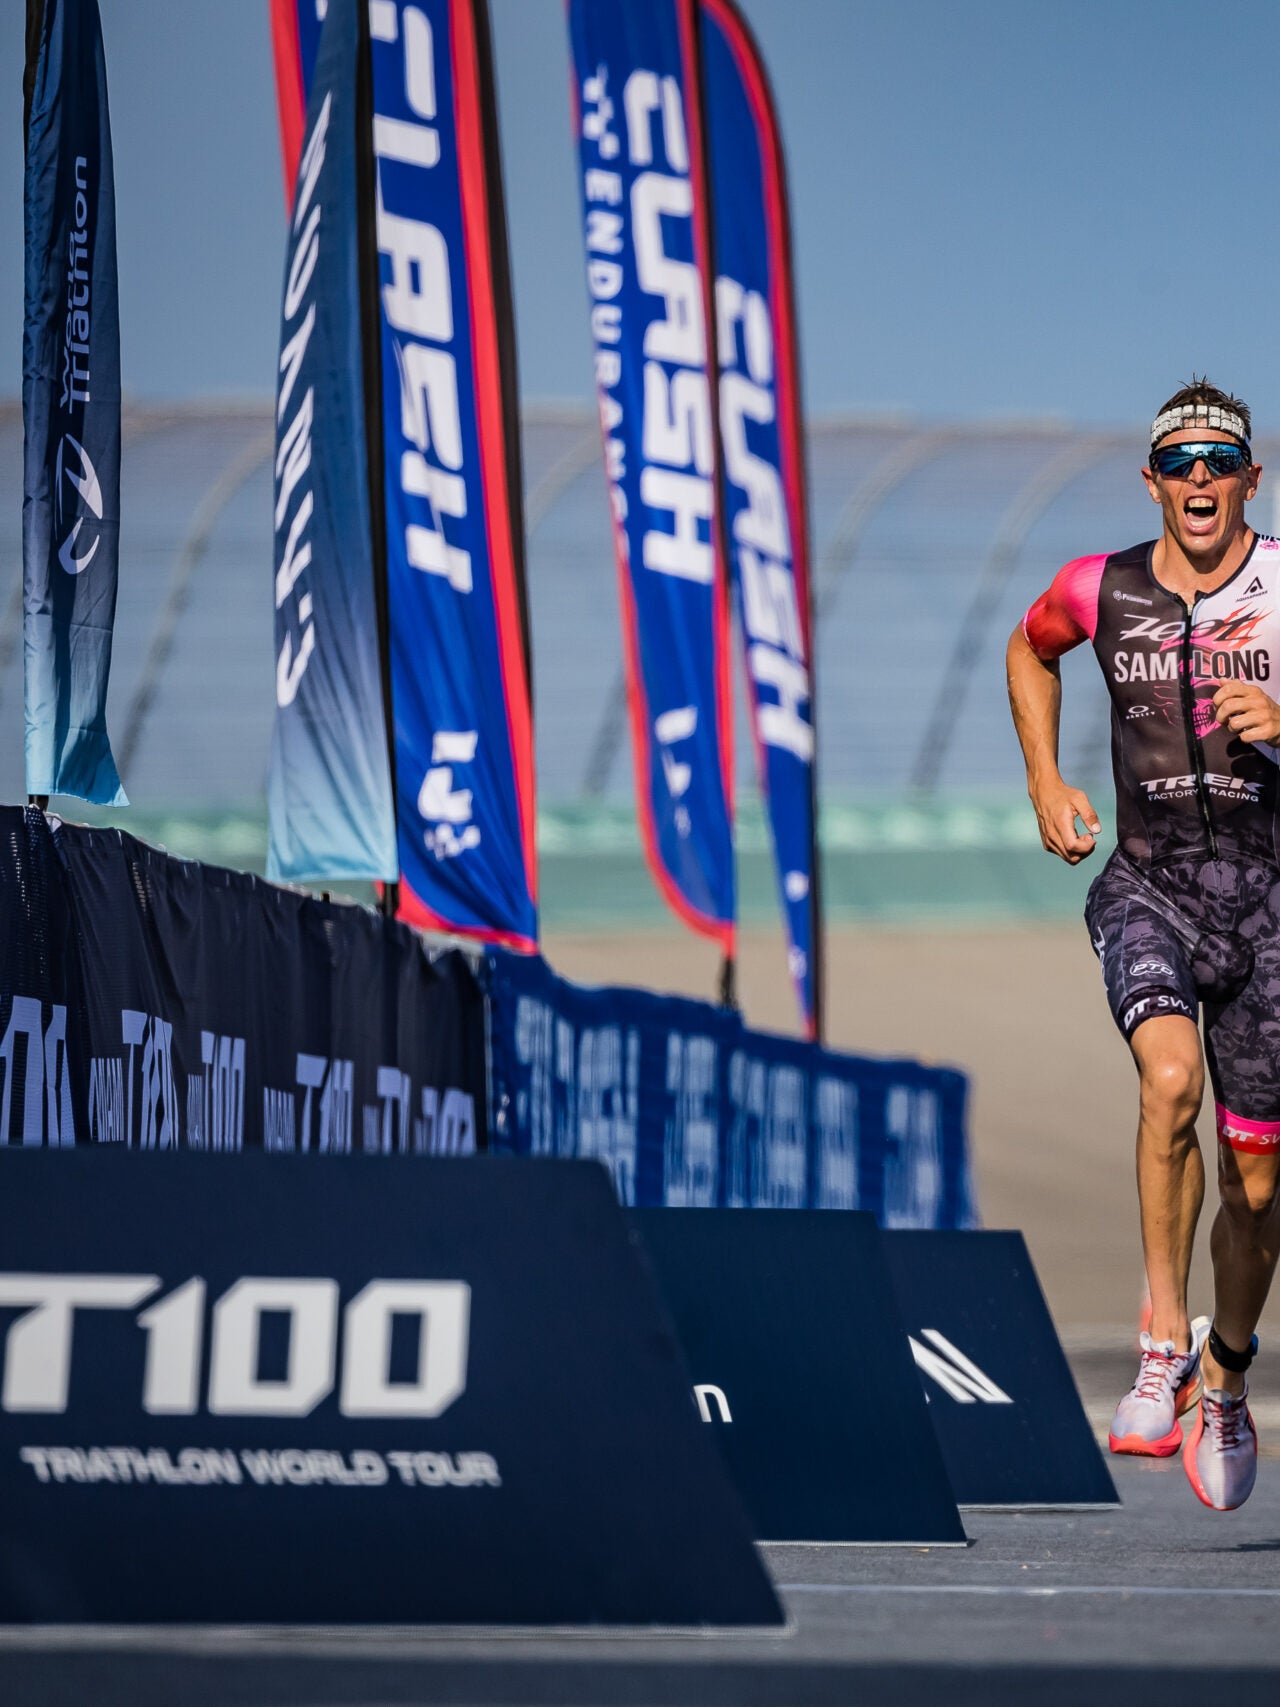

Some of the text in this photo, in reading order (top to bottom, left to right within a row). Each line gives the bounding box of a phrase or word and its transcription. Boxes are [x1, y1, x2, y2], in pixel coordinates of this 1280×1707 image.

[68, 156, 90, 414] Triathlon
[624, 67, 715, 586] CLASH
[585, 167, 630, 560] ENDURAN
[716, 275, 814, 762] CLASH
[1114, 649, 1271, 683] SAM LONG
[1140, 772, 1266, 794] TREK
[1148, 787, 1260, 802] FACTORY RACING
[1123, 998, 1151, 1031] DT
[1222, 1124, 1255, 1142] DT
[0, 1272, 472, 1419] T100
[20, 1446, 502, 1488] TRIATHLON WORLD TOUR
